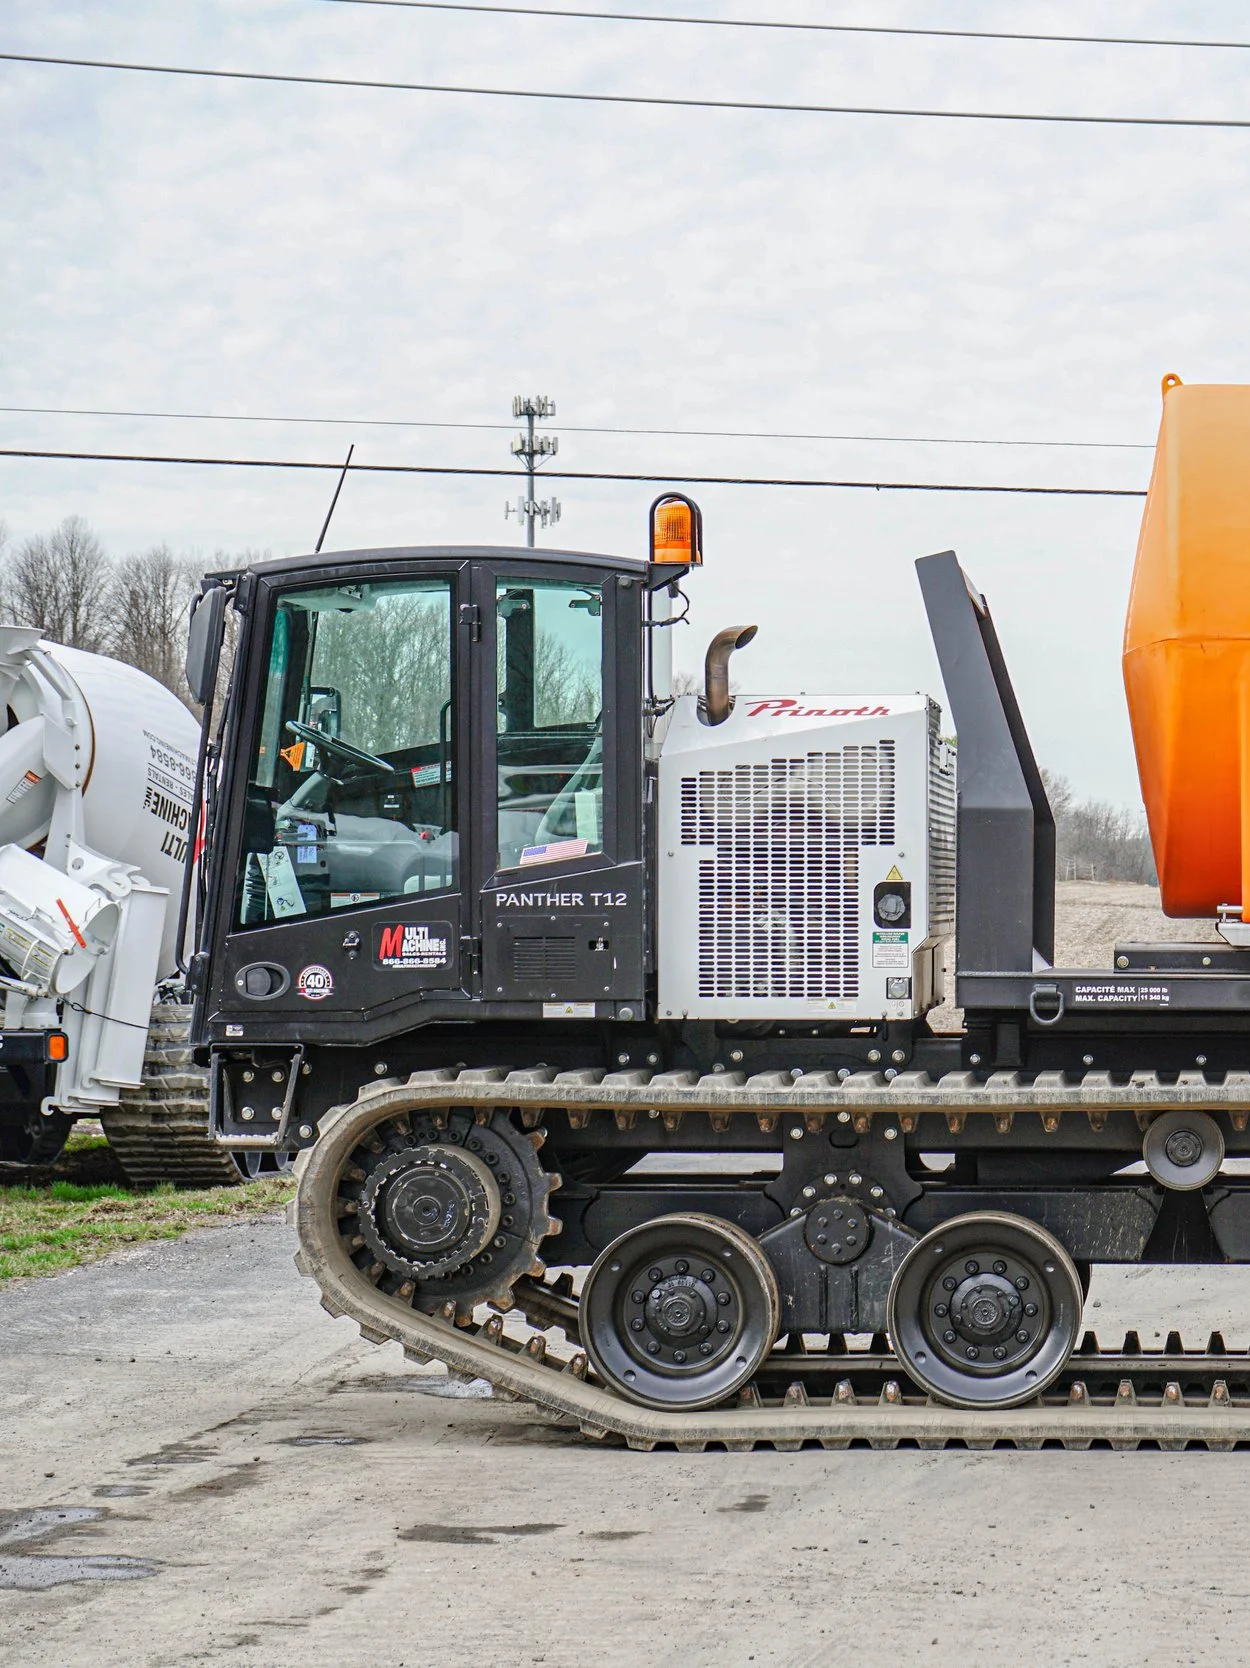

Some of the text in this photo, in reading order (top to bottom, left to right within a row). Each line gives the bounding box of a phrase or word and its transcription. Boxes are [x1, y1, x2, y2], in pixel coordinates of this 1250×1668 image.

[745, 699, 891, 717] Prinoth
[147, 767, 174, 790] RENTALS
[496, 893, 627, 907] PANTHER T12
[382, 957, 447, 965] 866-866-8584
[307, 974, 324, 988] 40
[1075, 985, 1116, 993] CAPACITÉ
